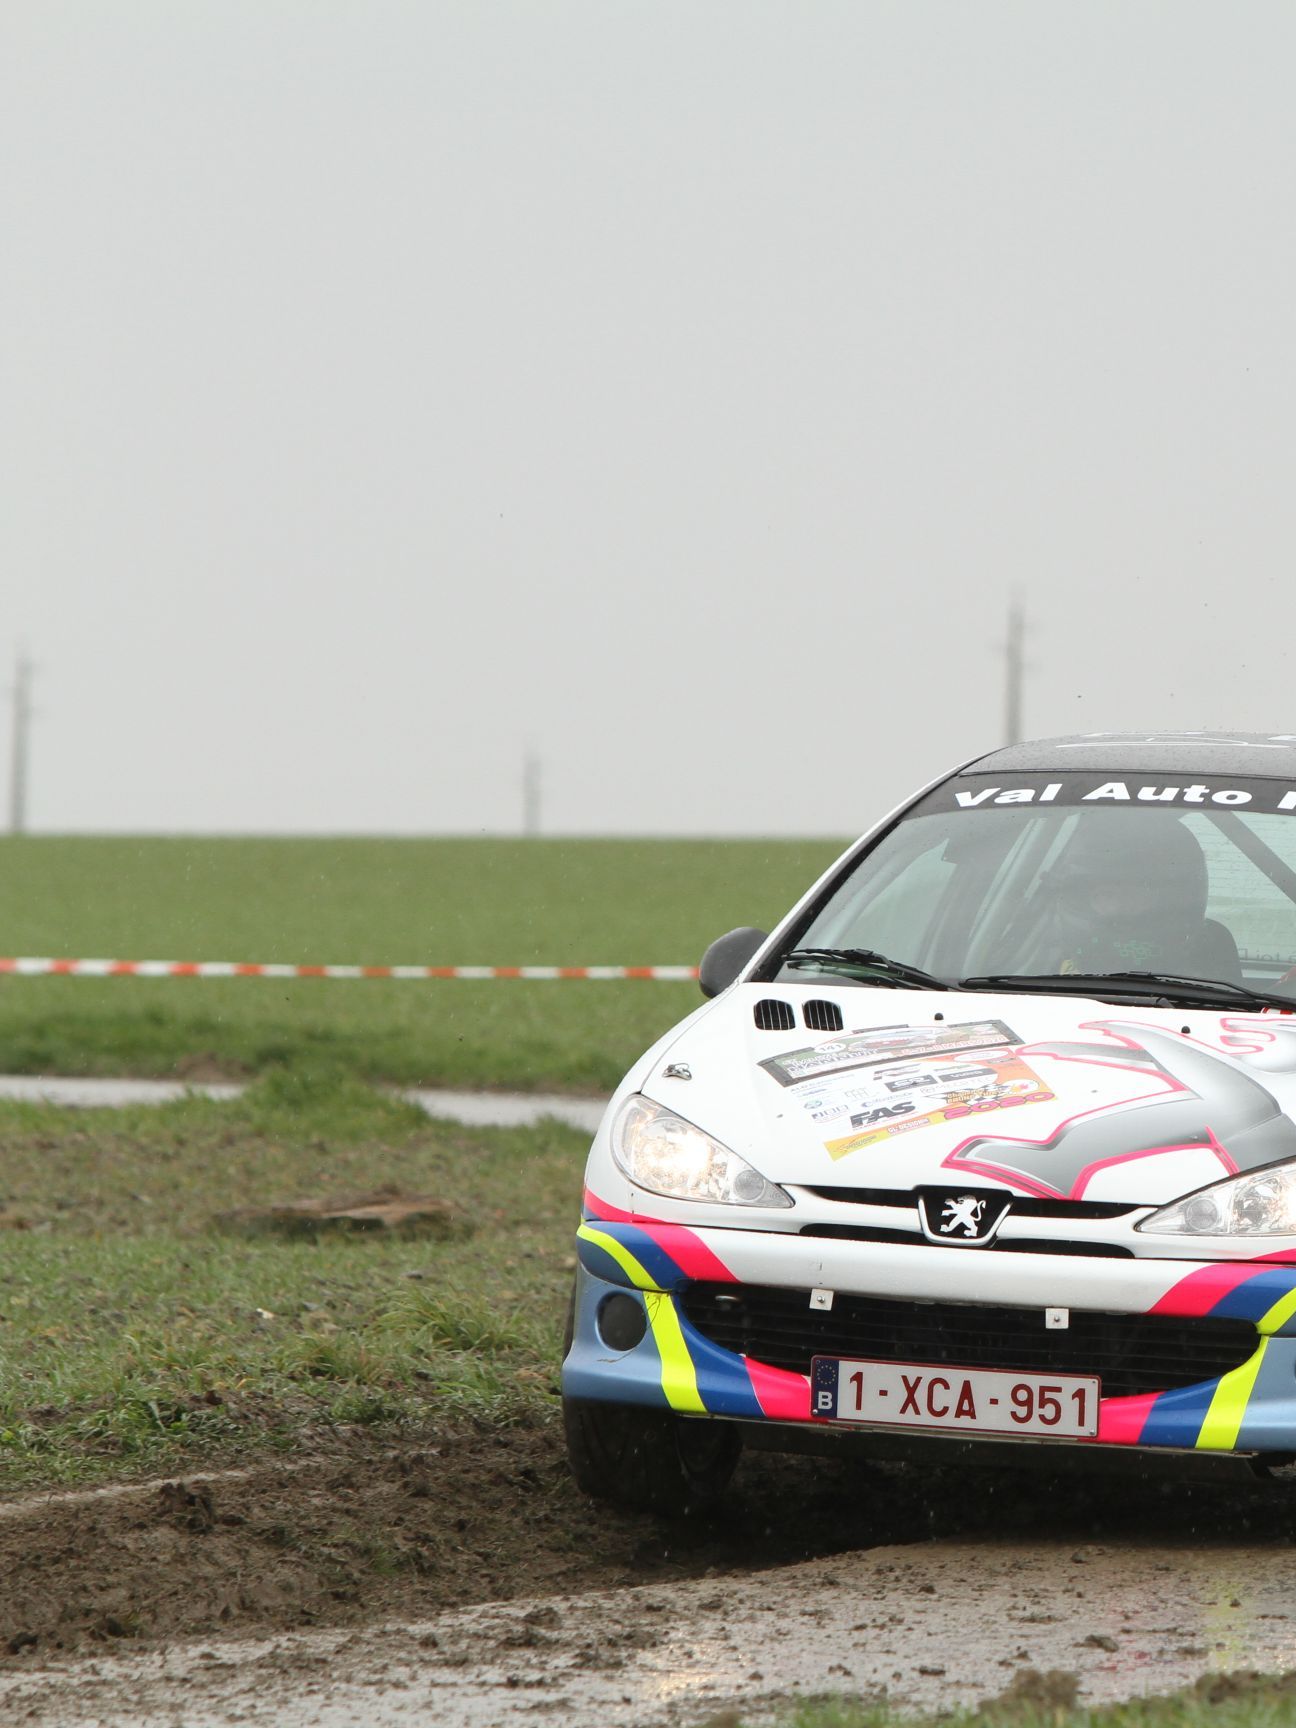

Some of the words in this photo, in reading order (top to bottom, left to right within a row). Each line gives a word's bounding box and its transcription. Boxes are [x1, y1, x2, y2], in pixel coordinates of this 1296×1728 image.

[954, 783, 1062, 808] Val
[1082, 782, 1253, 806] Auto
[821, 1044, 842, 1053] 141
[850, 1101, 916, 1128] FAS
[943, 1091, 1056, 1120] 2020
[817, 1391, 833, 1410] B
[849, 1371, 1086, 1427] 1-XCA-951
